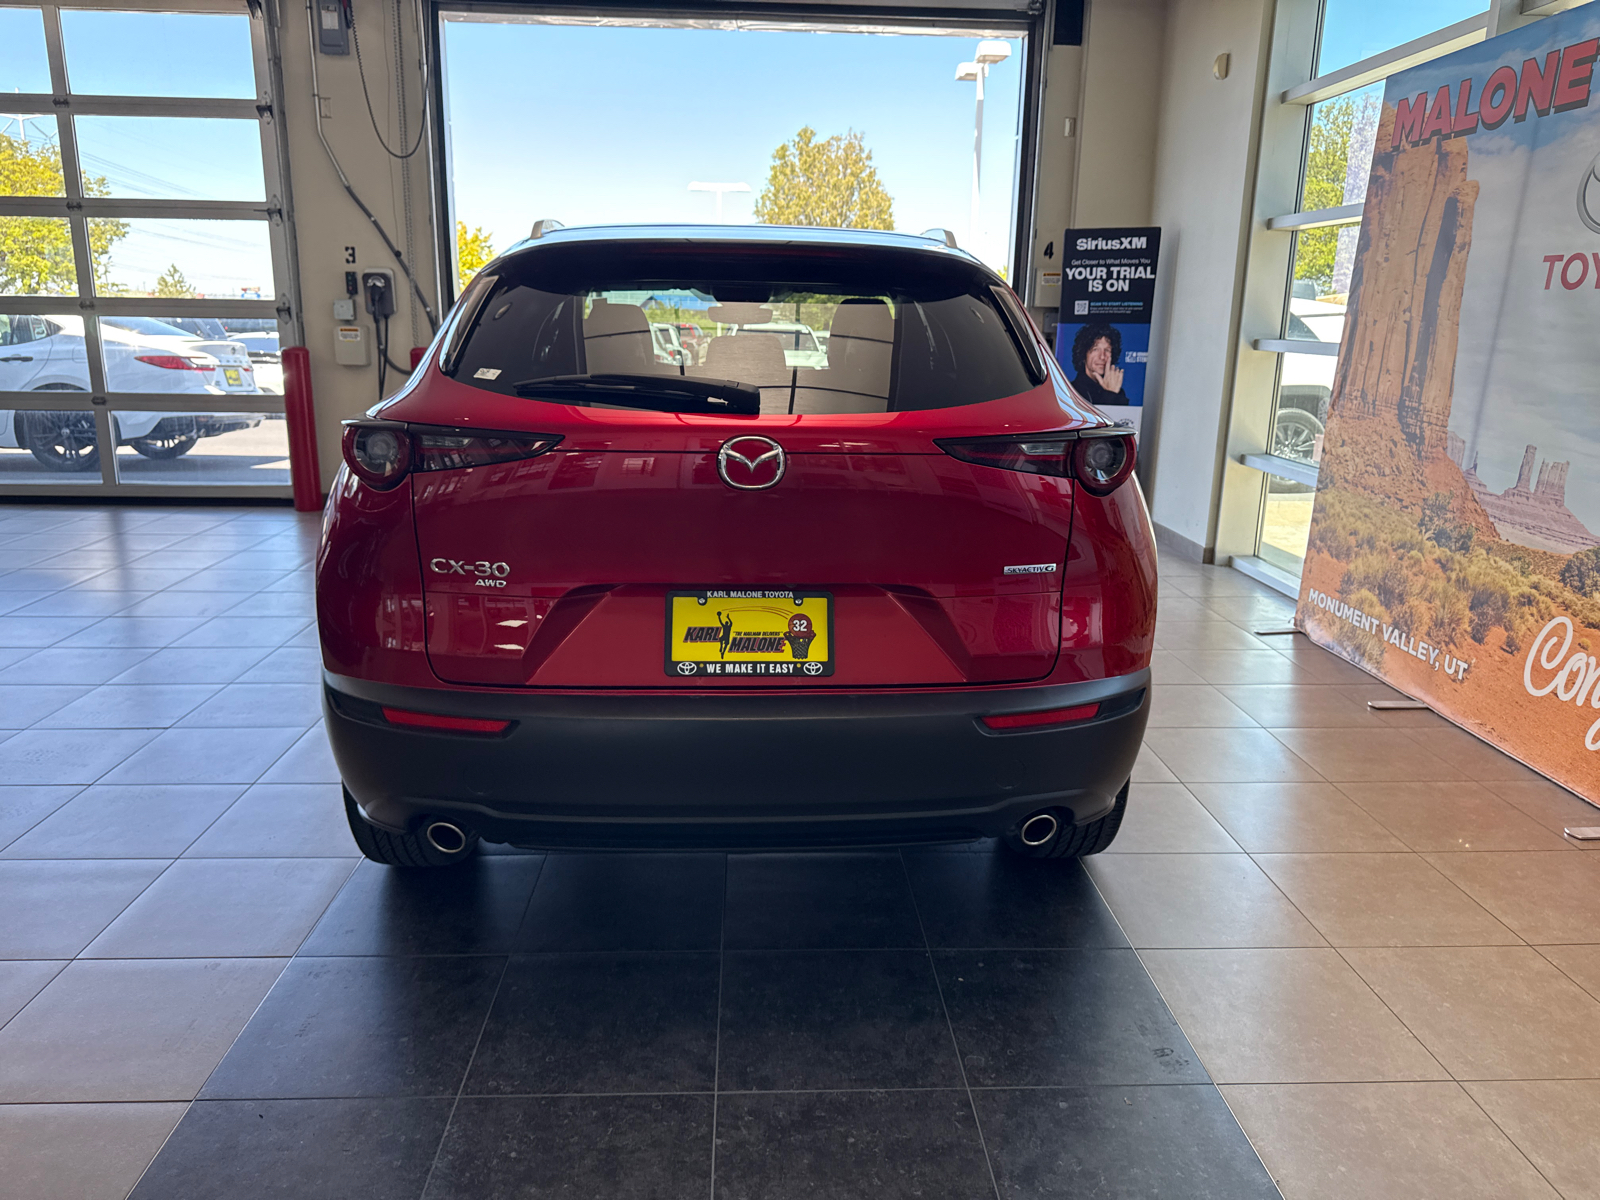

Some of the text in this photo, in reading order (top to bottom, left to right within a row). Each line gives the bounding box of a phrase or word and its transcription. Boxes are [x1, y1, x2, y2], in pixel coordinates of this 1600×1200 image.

[1391, 37, 1600, 150] MALONE
[1043, 241, 1054, 260] 4
[1076, 236, 1147, 251] SiriusXM
[345, 246, 356, 264] 3
[1065, 267, 1107, 280] YOUR
[1110, 266, 1155, 279] TRIAL
[1088, 279, 1130, 292] IS ON
[430, 558, 510, 577] CX-30
[475, 579, 507, 588] AWD
[793, 620, 807, 631] 32
[683, 626, 722, 642] KARL
[1308, 588, 1468, 680] MONUMENT VALLEY, UT
[728, 636, 787, 653] MALONE
[706, 663, 794, 673] WE MAKE IT EASY
